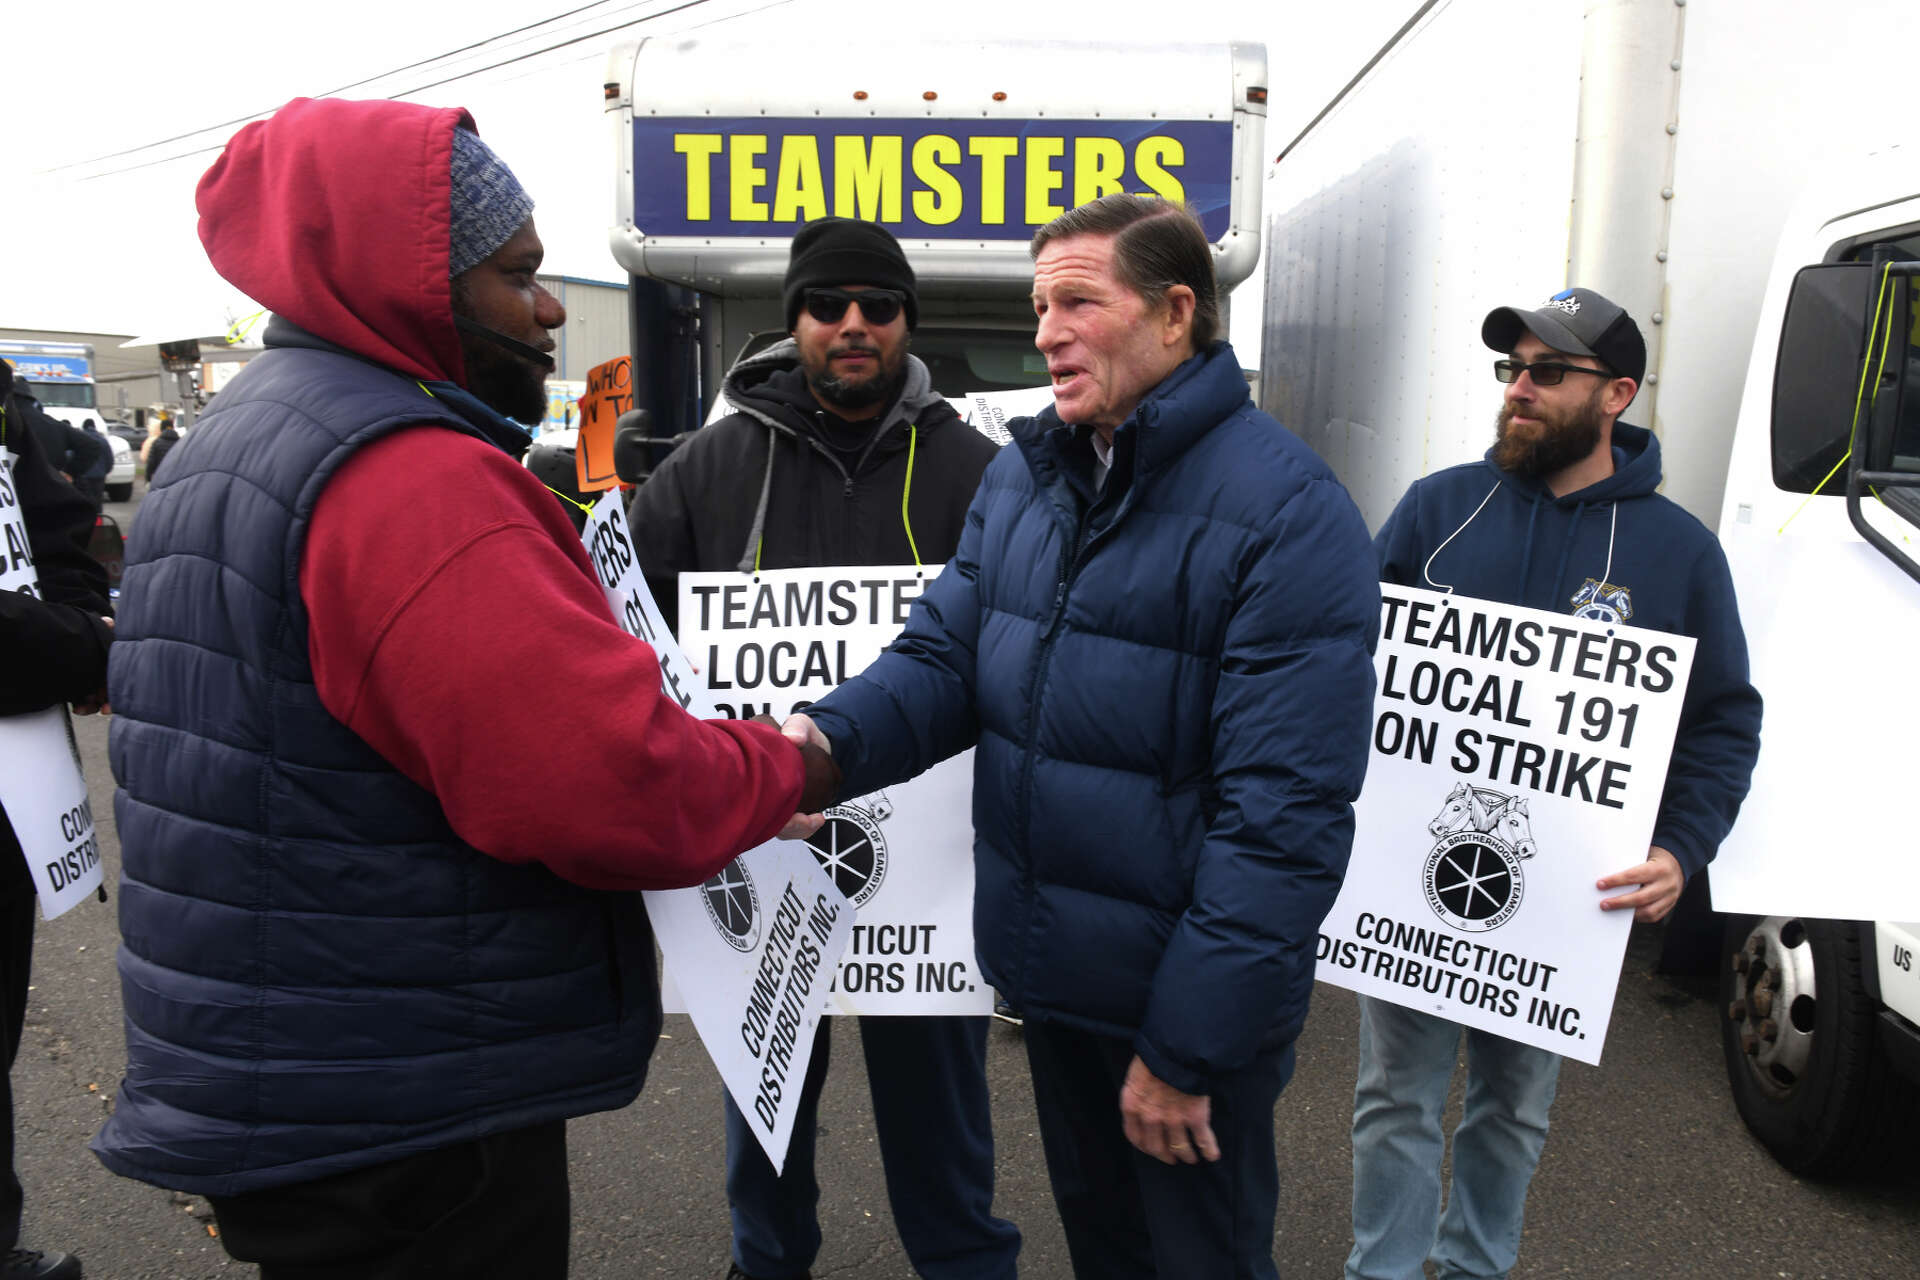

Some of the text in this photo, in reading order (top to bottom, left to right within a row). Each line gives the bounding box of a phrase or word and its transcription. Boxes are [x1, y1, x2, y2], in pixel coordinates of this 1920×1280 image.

[673, 133, 1186, 225] TEAMSTERS
[691, 579, 936, 631] TEAMSTE
[1382, 595, 1677, 693] TEAMSTERS
[1381, 654, 1639, 749] LOCAL 191
[1374, 711, 1632, 810] ON STRIKE
[854, 845, 885, 904] TEAMSTERS
[1447, 833, 1515, 865] BROTHERHOOD
[1484, 880, 1522, 928] TEAMSTERS
[741, 880, 806, 1059] CONNECTICUT
[915, 961, 975, 993] INC.
[1315, 934, 1586, 1040] DISTRIBUTORS INC.
[1356, 912, 1558, 993] CONNECTICUT
[1893, 944, 1912, 972] US
[754, 893, 840, 1135] DISTRIBUTORS INC.
